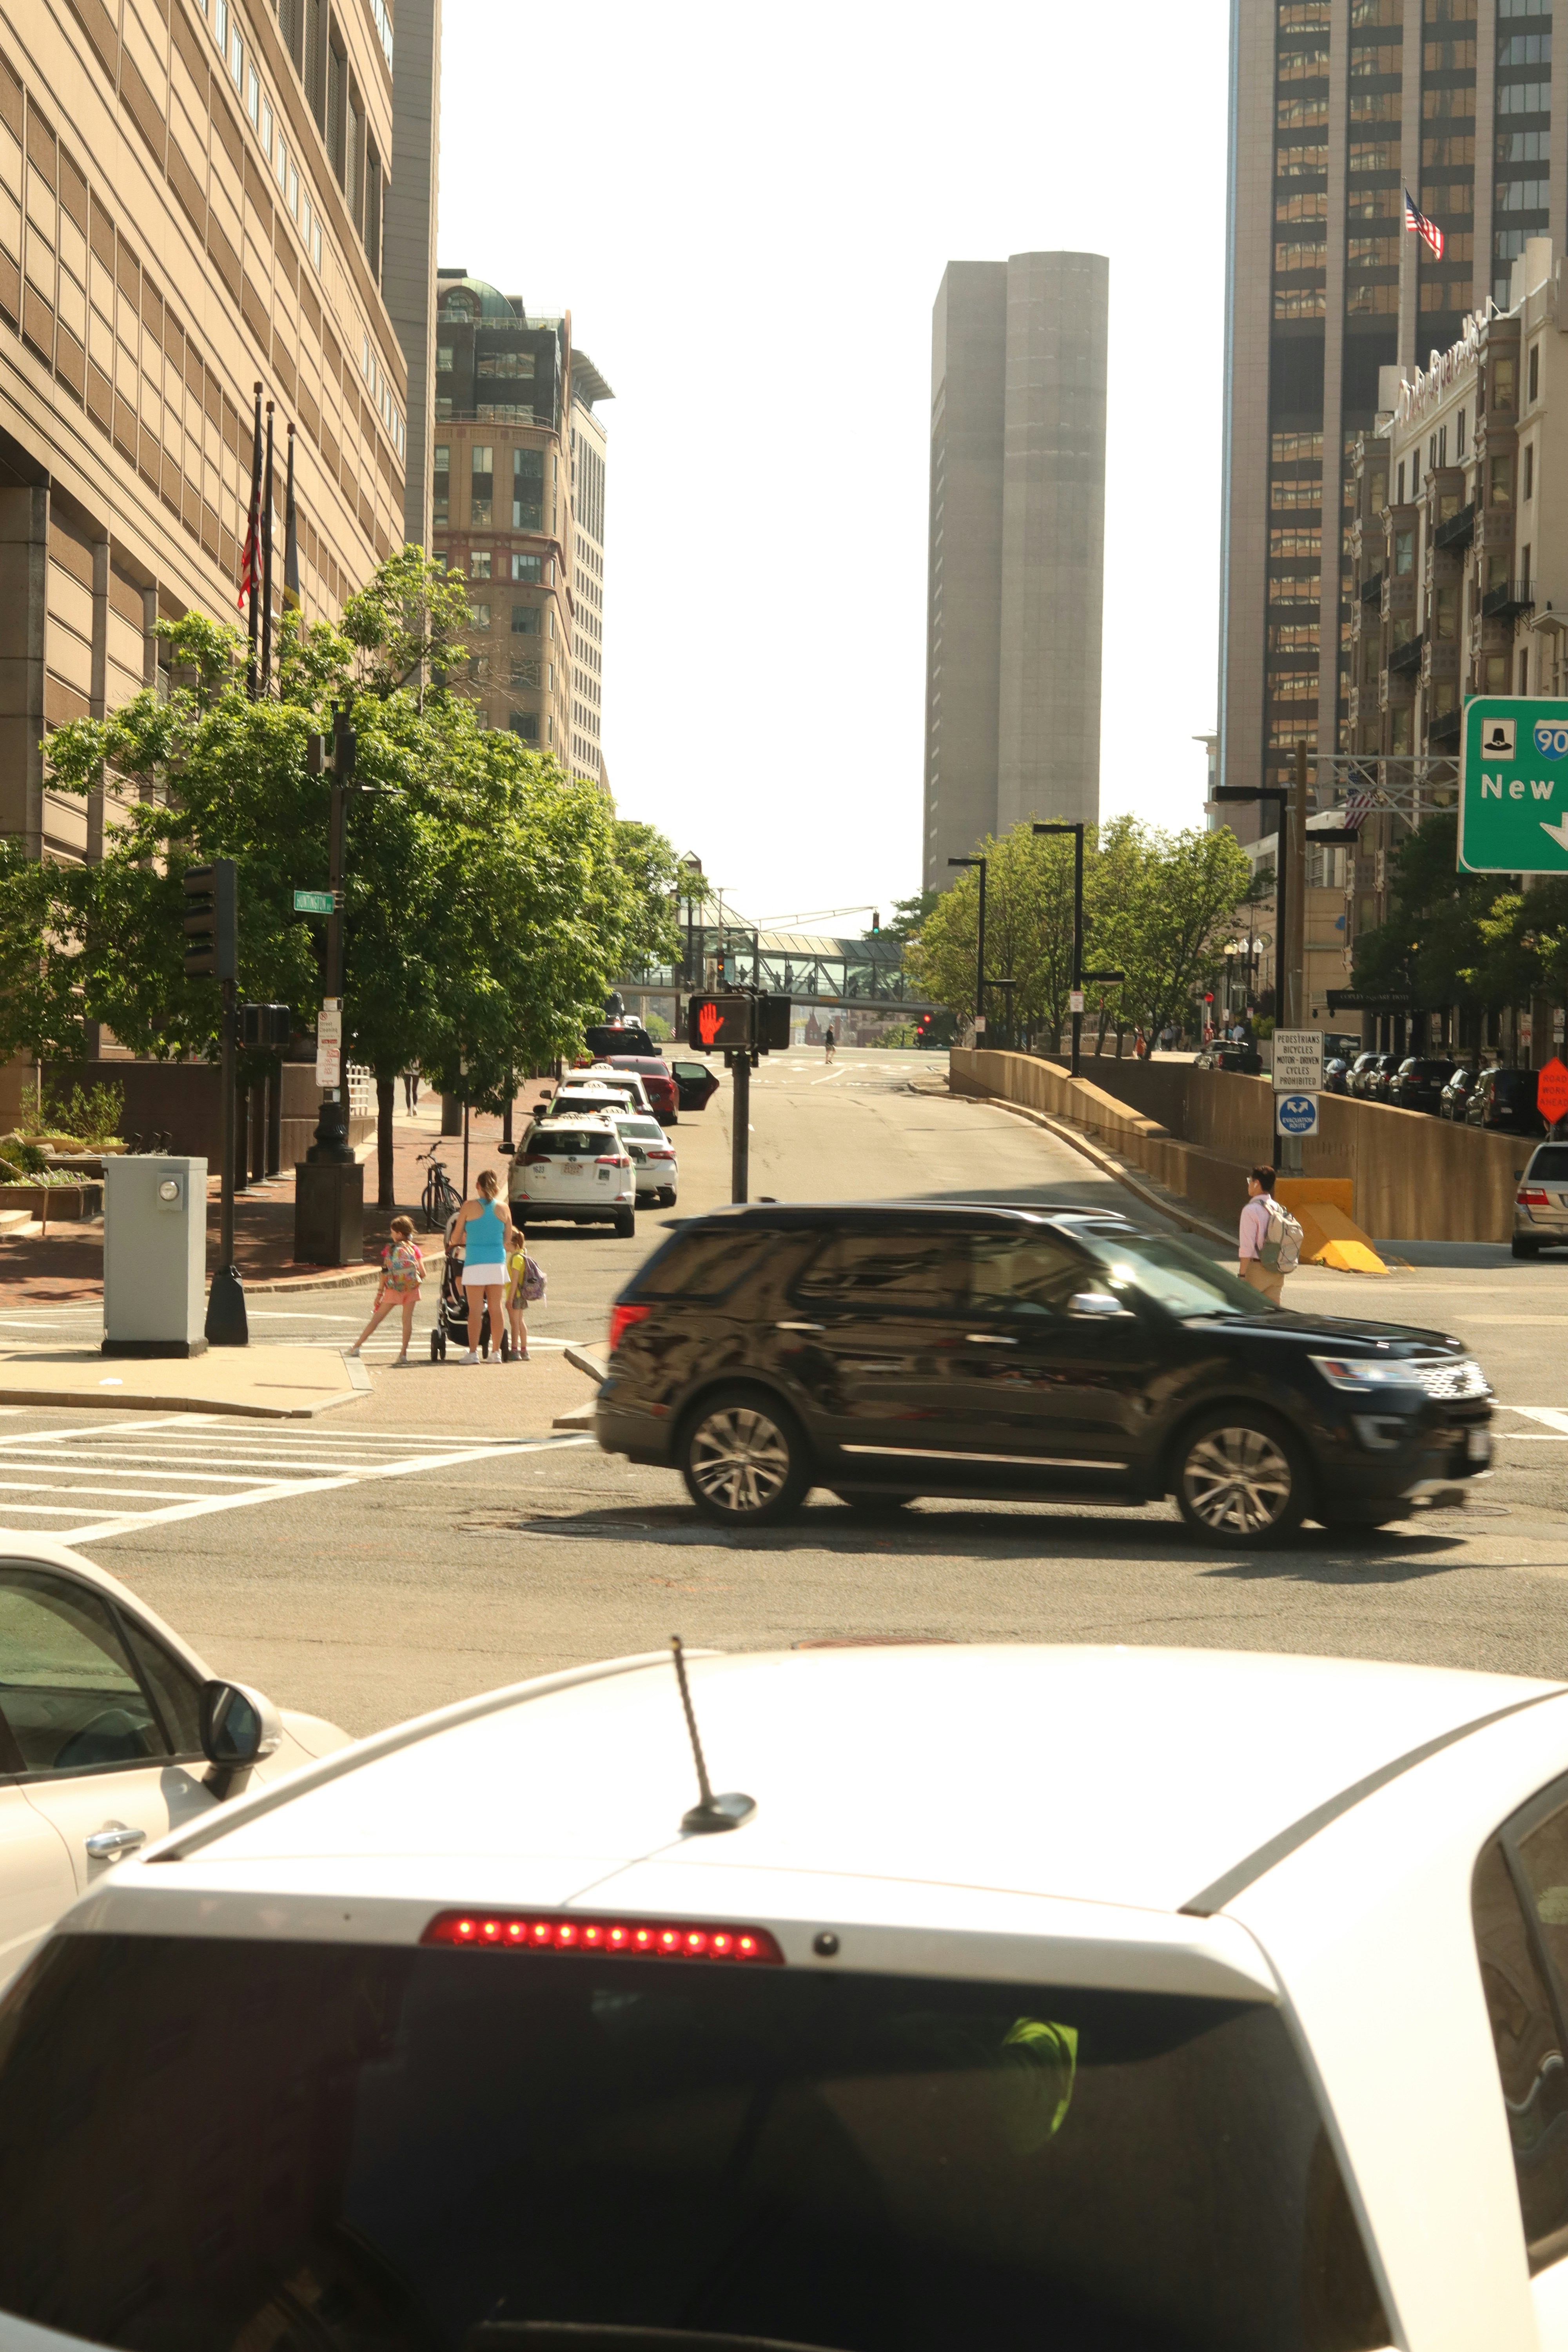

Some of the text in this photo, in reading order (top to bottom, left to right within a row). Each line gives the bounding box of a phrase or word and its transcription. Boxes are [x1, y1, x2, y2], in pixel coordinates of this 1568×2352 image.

[1537, 730, 1568, 753] 90
[1481, 773, 1555, 800] New
[296, 893, 327, 911] HUNTINGTON
[1278, 1035, 1320, 1044] PEDESTRIANS
[1283, 1046, 1313, 1054] BICYCLES
[1286, 1067, 1310, 1075] CYCLES
[1279, 1077, 1316, 1085] PROHIBITED
[1543, 1075, 1567, 1083] ROAD
[1541, 1098, 1568, 1107] AHEAD
